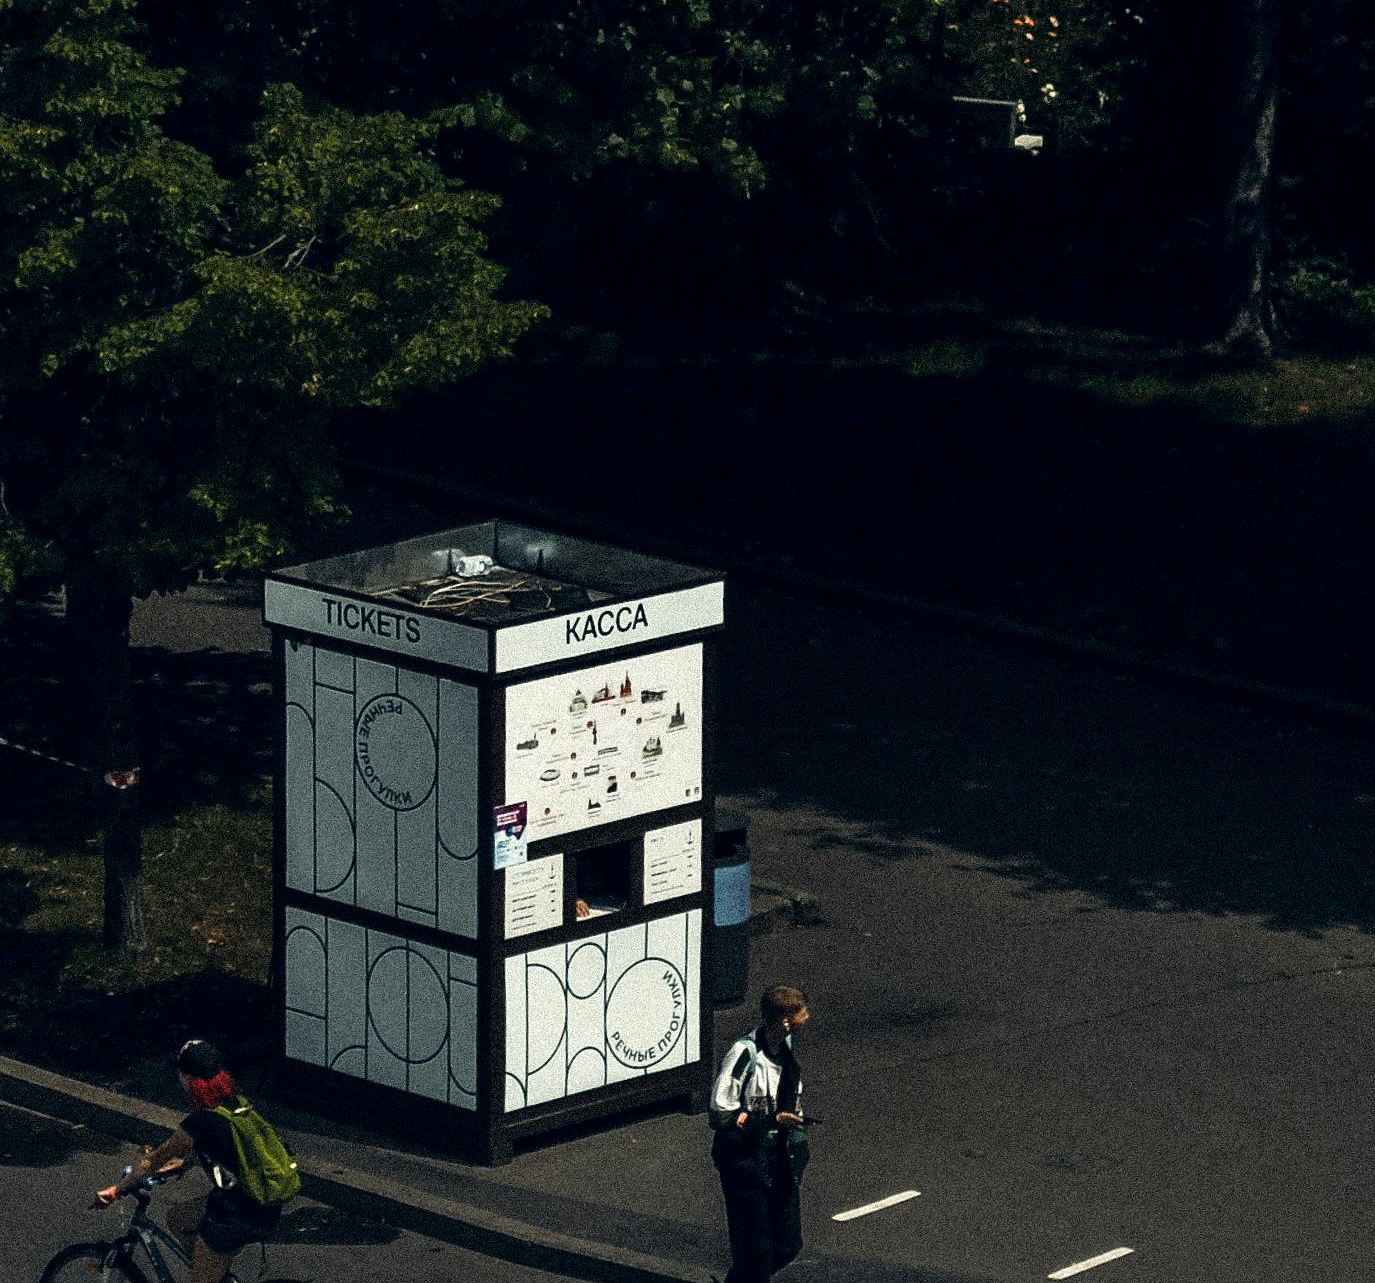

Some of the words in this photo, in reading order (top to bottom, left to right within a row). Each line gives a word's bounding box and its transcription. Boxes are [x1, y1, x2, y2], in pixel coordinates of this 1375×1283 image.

[322, 598, 421, 644] TICKETS
[566, 603, 649, 645] КАССА
[359, 699, 403, 738] РЕЧНЫЕ
[359, 742, 412, 805] ПРОГУЛКИ
[611, 1031, 656, 1062] РЕЧНЫЕ
[657, 970, 681, 1052] ПРОГУЛКИ
